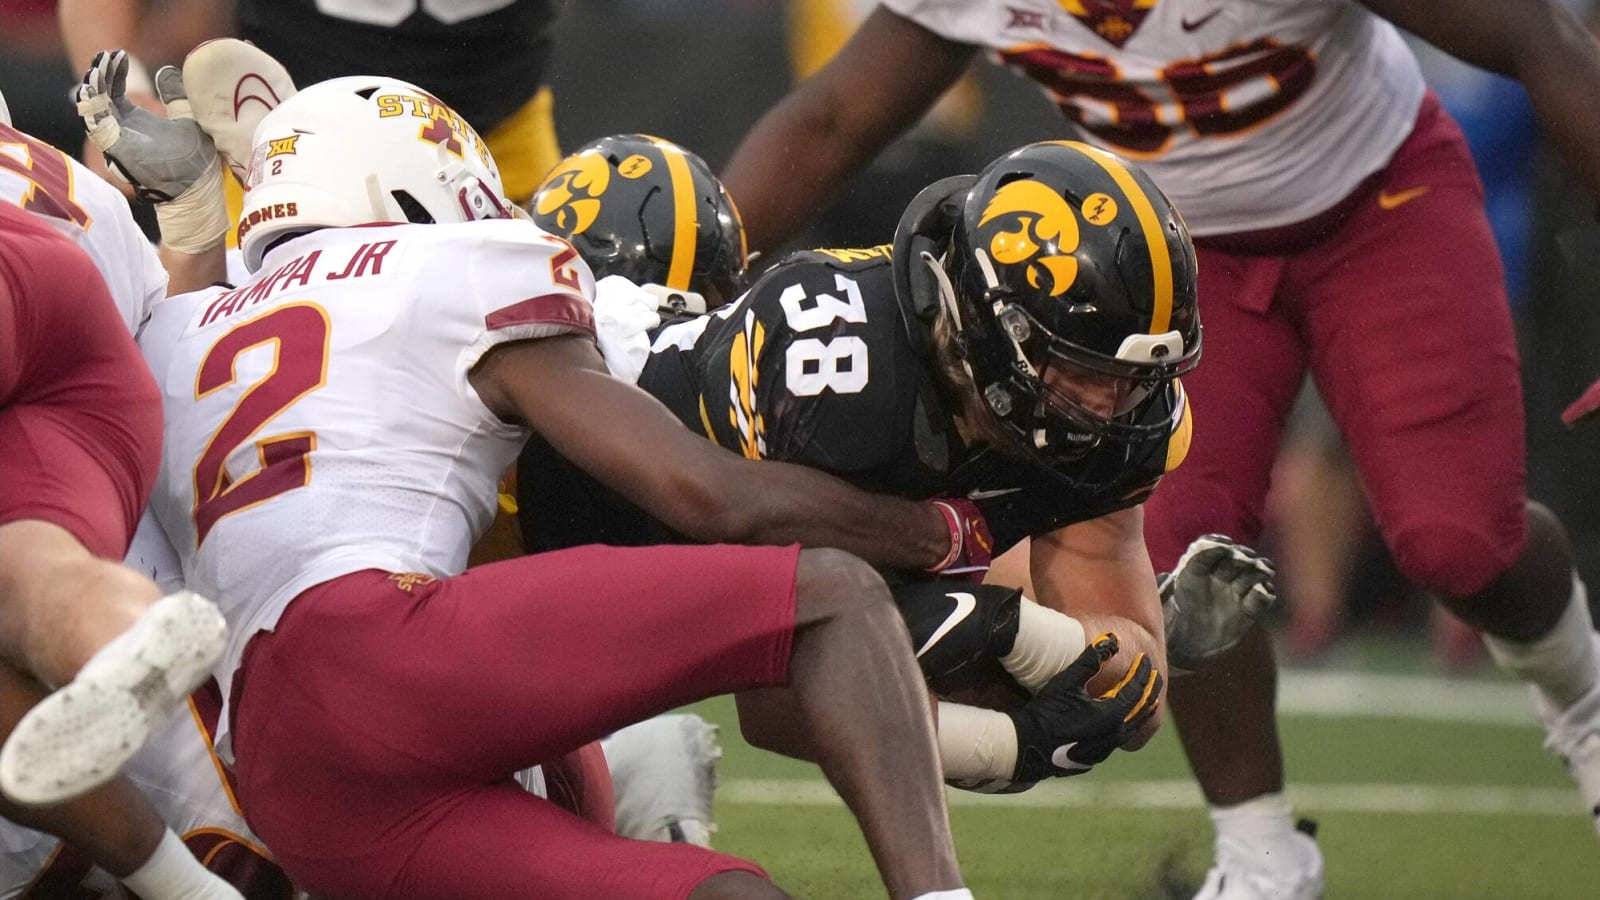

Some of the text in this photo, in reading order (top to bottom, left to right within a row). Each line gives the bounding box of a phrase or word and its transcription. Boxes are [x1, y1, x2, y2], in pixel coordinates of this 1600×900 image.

[265, 134, 300, 160] XII
[271, 159, 282, 176] 2
[199, 239, 398, 328] TAMPA JR
[542, 234, 582, 294] 2
[779, 273, 869, 397] 38
[192, 300, 333, 553] 2
